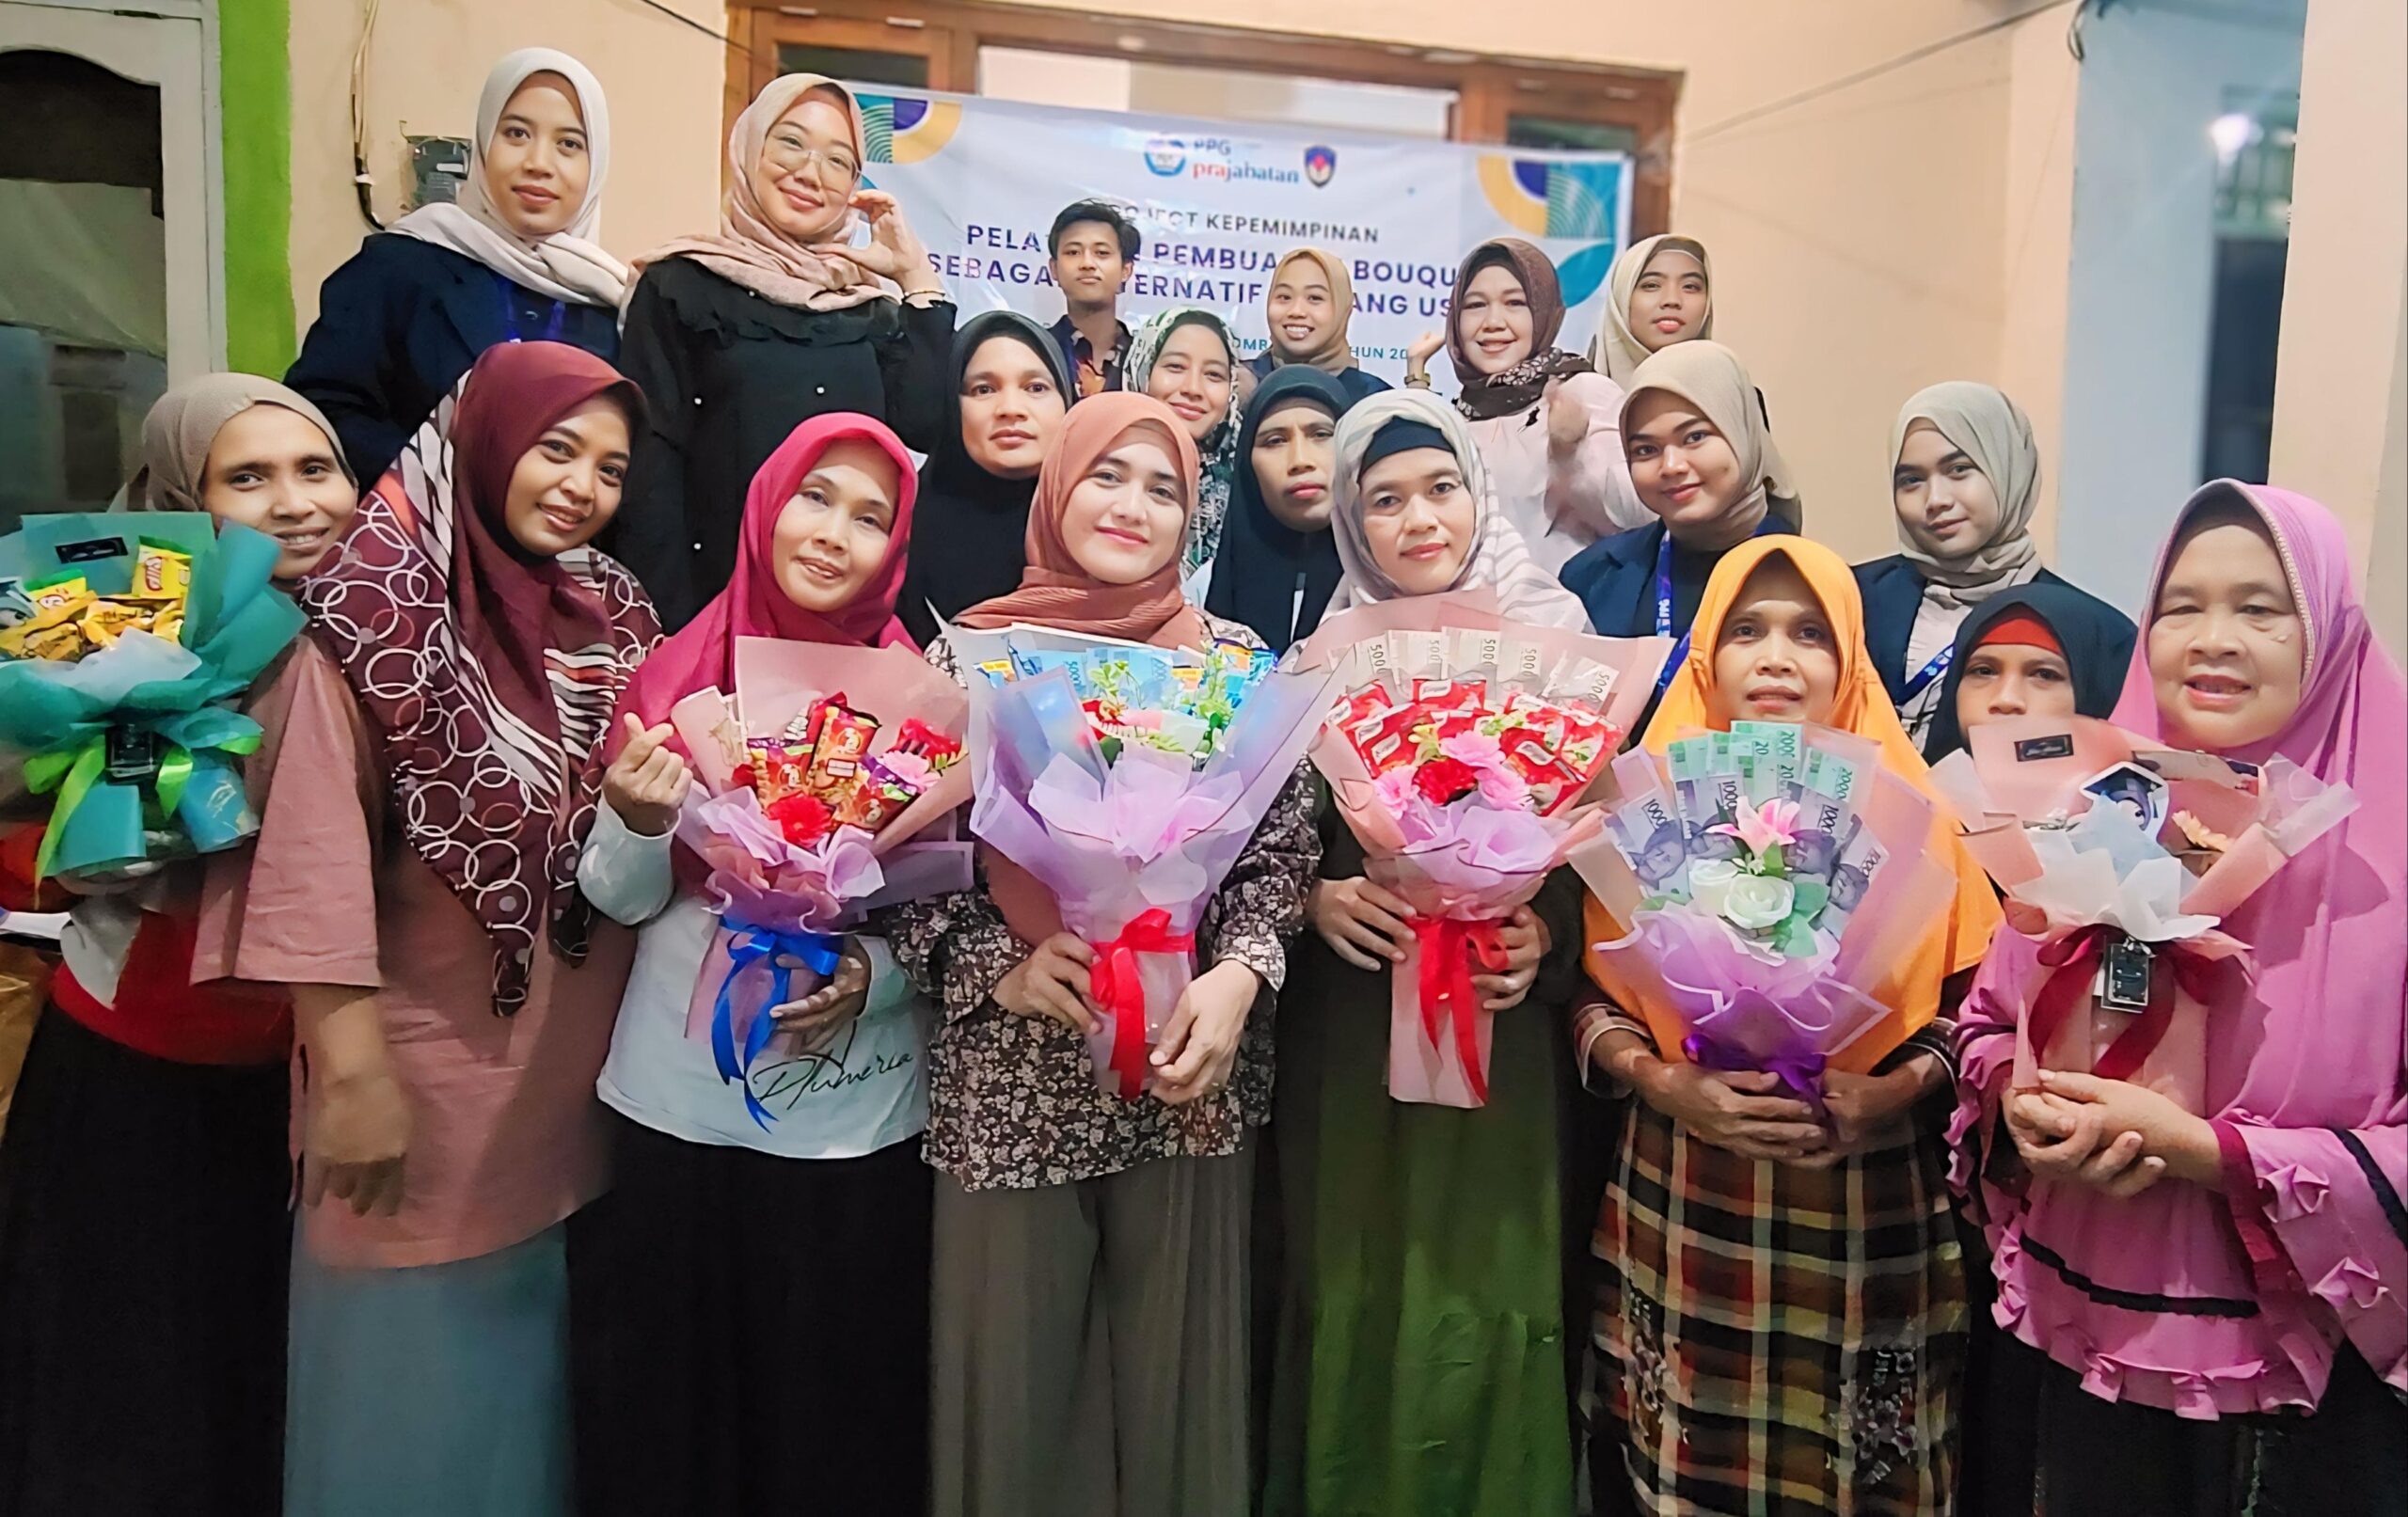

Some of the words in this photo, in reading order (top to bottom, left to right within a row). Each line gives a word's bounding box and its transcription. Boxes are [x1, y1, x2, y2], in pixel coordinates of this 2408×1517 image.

[1193, 160, 1299, 183] prajabatan
[1207, 213, 1378, 243] KEPEMIMPINAN
[967, 224, 1042, 252] PELA
[1154, 242, 1276, 273] PEMBUA
[1354, 260, 1456, 289] BOUQU
[927, 252, 1054, 287] SEBAGA
[1133, 273, 1262, 304] ERNATIF
[1419, 296, 1450, 317] US
[1349, 345, 1384, 359] HUN
